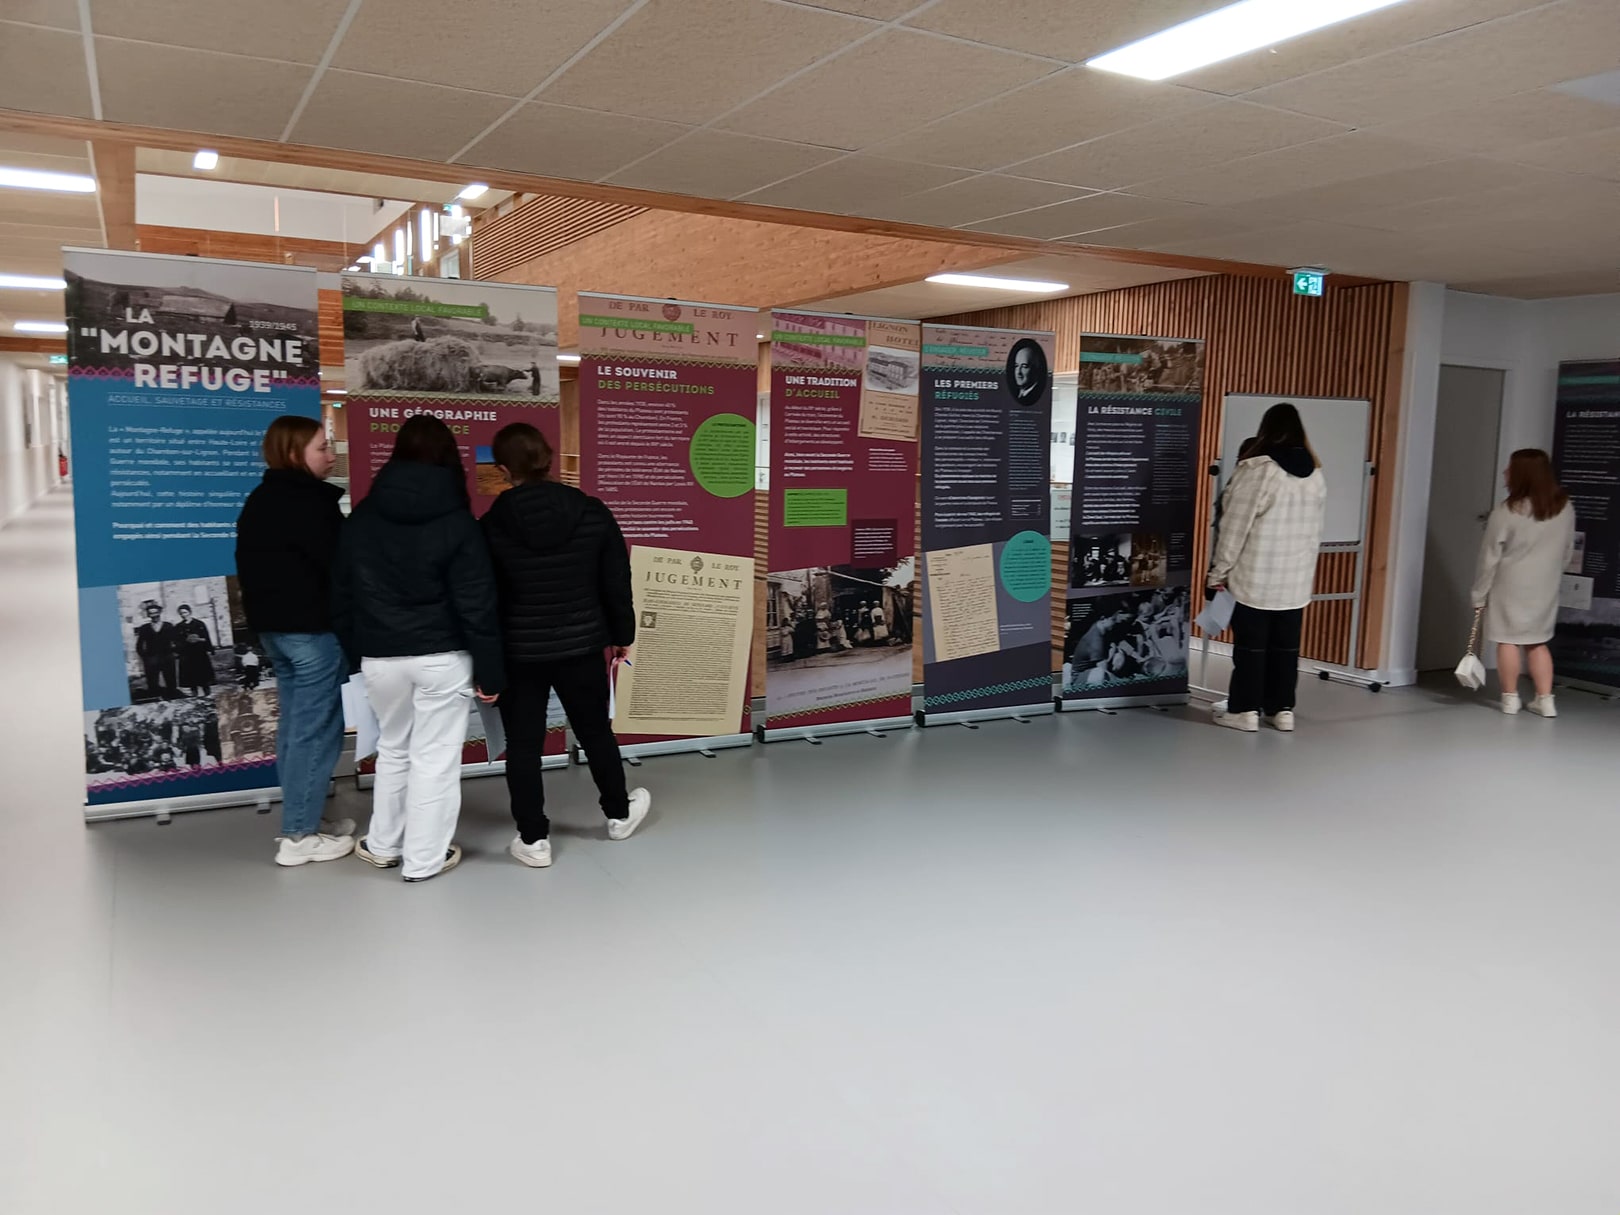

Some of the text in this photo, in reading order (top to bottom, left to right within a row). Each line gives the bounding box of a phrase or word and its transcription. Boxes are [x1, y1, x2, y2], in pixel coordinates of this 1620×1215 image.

[368, 302, 409, 311] CONTEXTE
[411, 304, 435, 313] LOCAL
[438, 306, 482, 314] FAVORABLE
[608, 301, 733, 320] DE PAR LE ROY
[126, 306, 154, 324] LA
[248, 320, 297, 331] 1939/1945
[600, 327, 739, 347] JUGEMENT
[81, 327, 302, 363] "MONTAGNE
[134, 363, 287, 393] REFUGE"
[597, 366, 678, 379] LE SOUVENIR
[598, 380, 715, 394] DES PERSÉCUTIONS
[785, 376, 857, 388] UNE TRADITION
[934, 380, 999, 390] LES PREMIERS
[785, 388, 840, 399] D'ACCUEIL
[934, 390, 979, 400] RÉFUGIÉS
[154, 397, 208, 406] SAUVETAGE
[212, 398, 222, 406] ET
[225, 398, 286, 410] RÉSISTANCES
[1088, 406, 1099, 414] LA
[1100, 405, 1153, 415] RÉSISTANCE
[369, 406, 497, 421] UNE GÉOGRAPHIE
[646, 572, 742, 590] JUGEMENT
